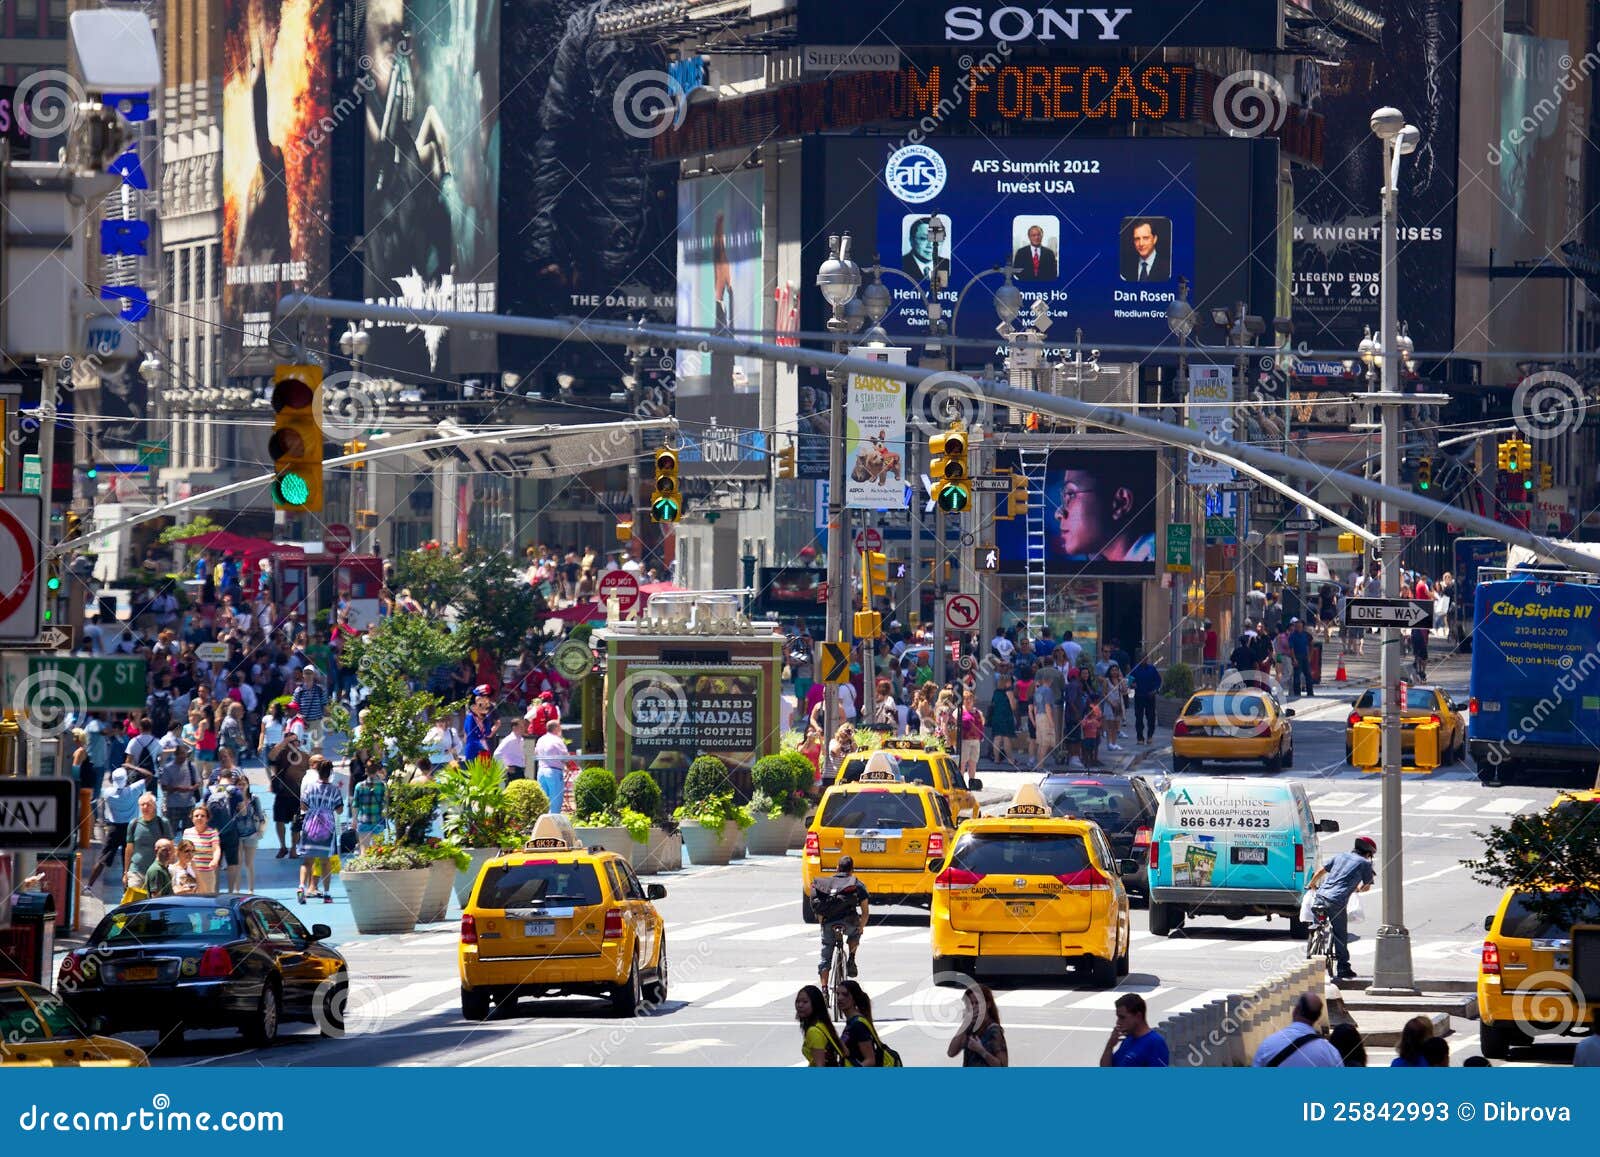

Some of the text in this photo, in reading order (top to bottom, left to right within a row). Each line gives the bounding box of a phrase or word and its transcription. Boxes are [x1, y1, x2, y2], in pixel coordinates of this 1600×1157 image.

[944, 7, 1132, 41] SONY
[808, 51, 896, 66] SHERWOOD
[968, 65, 1193, 120] FORECAST
[972, 160, 1101, 173] AFS Summit 2012
[997, 180, 1076, 193] Invest USA
[1312, 226, 1381, 240] KNIGHT
[249, 263, 280, 284] KNIGHT
[1299, 272, 1344, 282] LEGEND
[1348, 272, 1380, 282] ENDS
[893, 288, 930, 300] Hen
[1018, 289, 1068, 301] omas Ho
[1114, 290, 1176, 302] Dan Rosen
[1350, 282, 1380, 297] 20
[570, 294, 600, 307] THE
[605, 295, 647, 308] DARK
[900, 308, 915, 316] AFS
[1114, 309, 1150, 318] Rhodium
[1296, 362, 1347, 376] Van Wagn
[854, 375, 902, 394] BARKS
[991, 480, 1007, 489] WAY
[605, 577, 633, 586] DO NOT
[1357, 607, 1421, 619] ONE WAY
[1573, 605, 1593, 619] NY
[1506, 655, 1524, 664] Hop
[1525, 656, 1536, 664] on
[71, 662, 103, 703] 46
[114, 662, 137, 685] ST
[636, 699, 753, 709] FRESH BAKED
[635, 710, 753, 724] EMPANADAS
[635, 738, 673, 746] SWEETS
[1196, 794, 1264, 809] AliGraphics
[535, 839, 556, 848] 6K32
[971, 887, 997, 895] CAUTION
